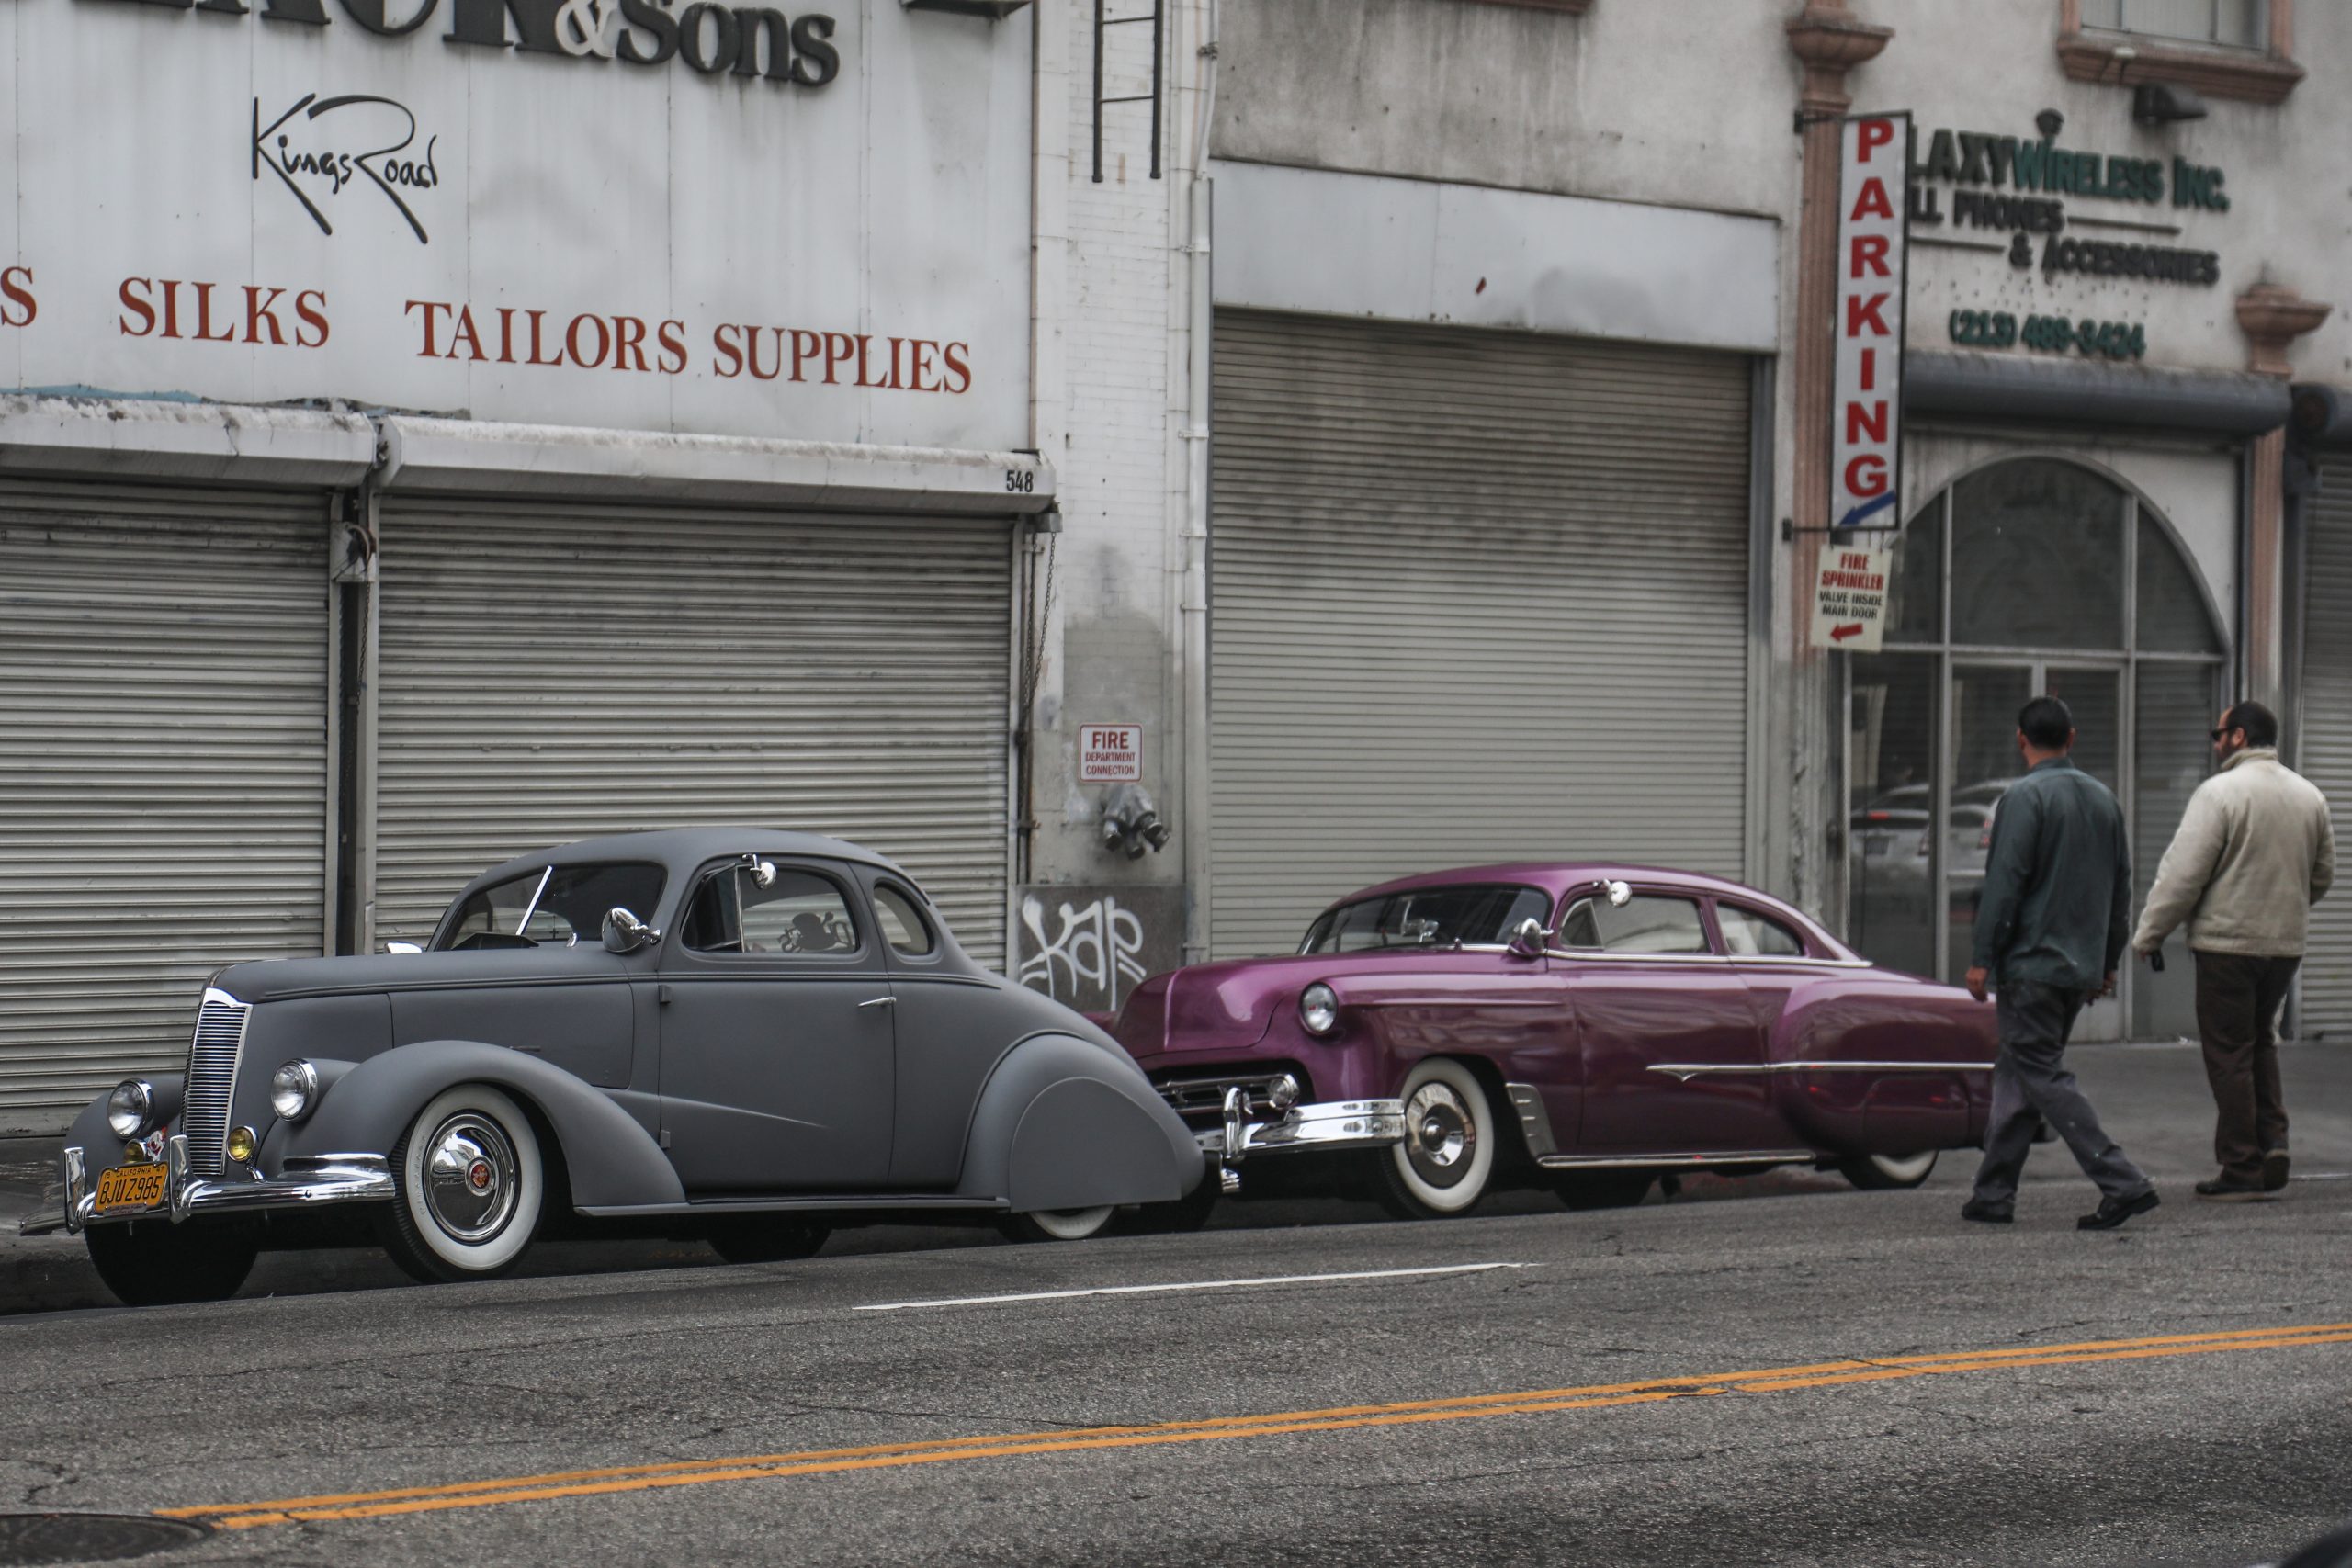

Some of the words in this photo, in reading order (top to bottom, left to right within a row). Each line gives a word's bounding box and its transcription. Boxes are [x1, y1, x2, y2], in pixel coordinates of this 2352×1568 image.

[1953, 188, 2065, 233] PHONES
[2009, 231, 2033, 269] &
[1843, 117, 1895, 498] PARKING
[119, 276, 330, 347] SILKS
[405, 299, 688, 375] TAILORS
[713, 323, 972, 394] SUPPLIES
[1006, 469, 1034, 493] 548
[1840, 553, 1870, 570] FIRE
[1822, 570, 1884, 592] SPRINKLER
[1819, 590, 1849, 604] VALVE
[1851, 593, 1883, 607] INSIDE
[1822, 604, 1848, 617] MAIN
[1851, 607, 1878, 620] DOOR
[1091, 731, 1130, 750] FIRE
[1085, 751, 1136, 762] DEPARTMENT
[1086, 764, 1136, 775] CONNECTION
